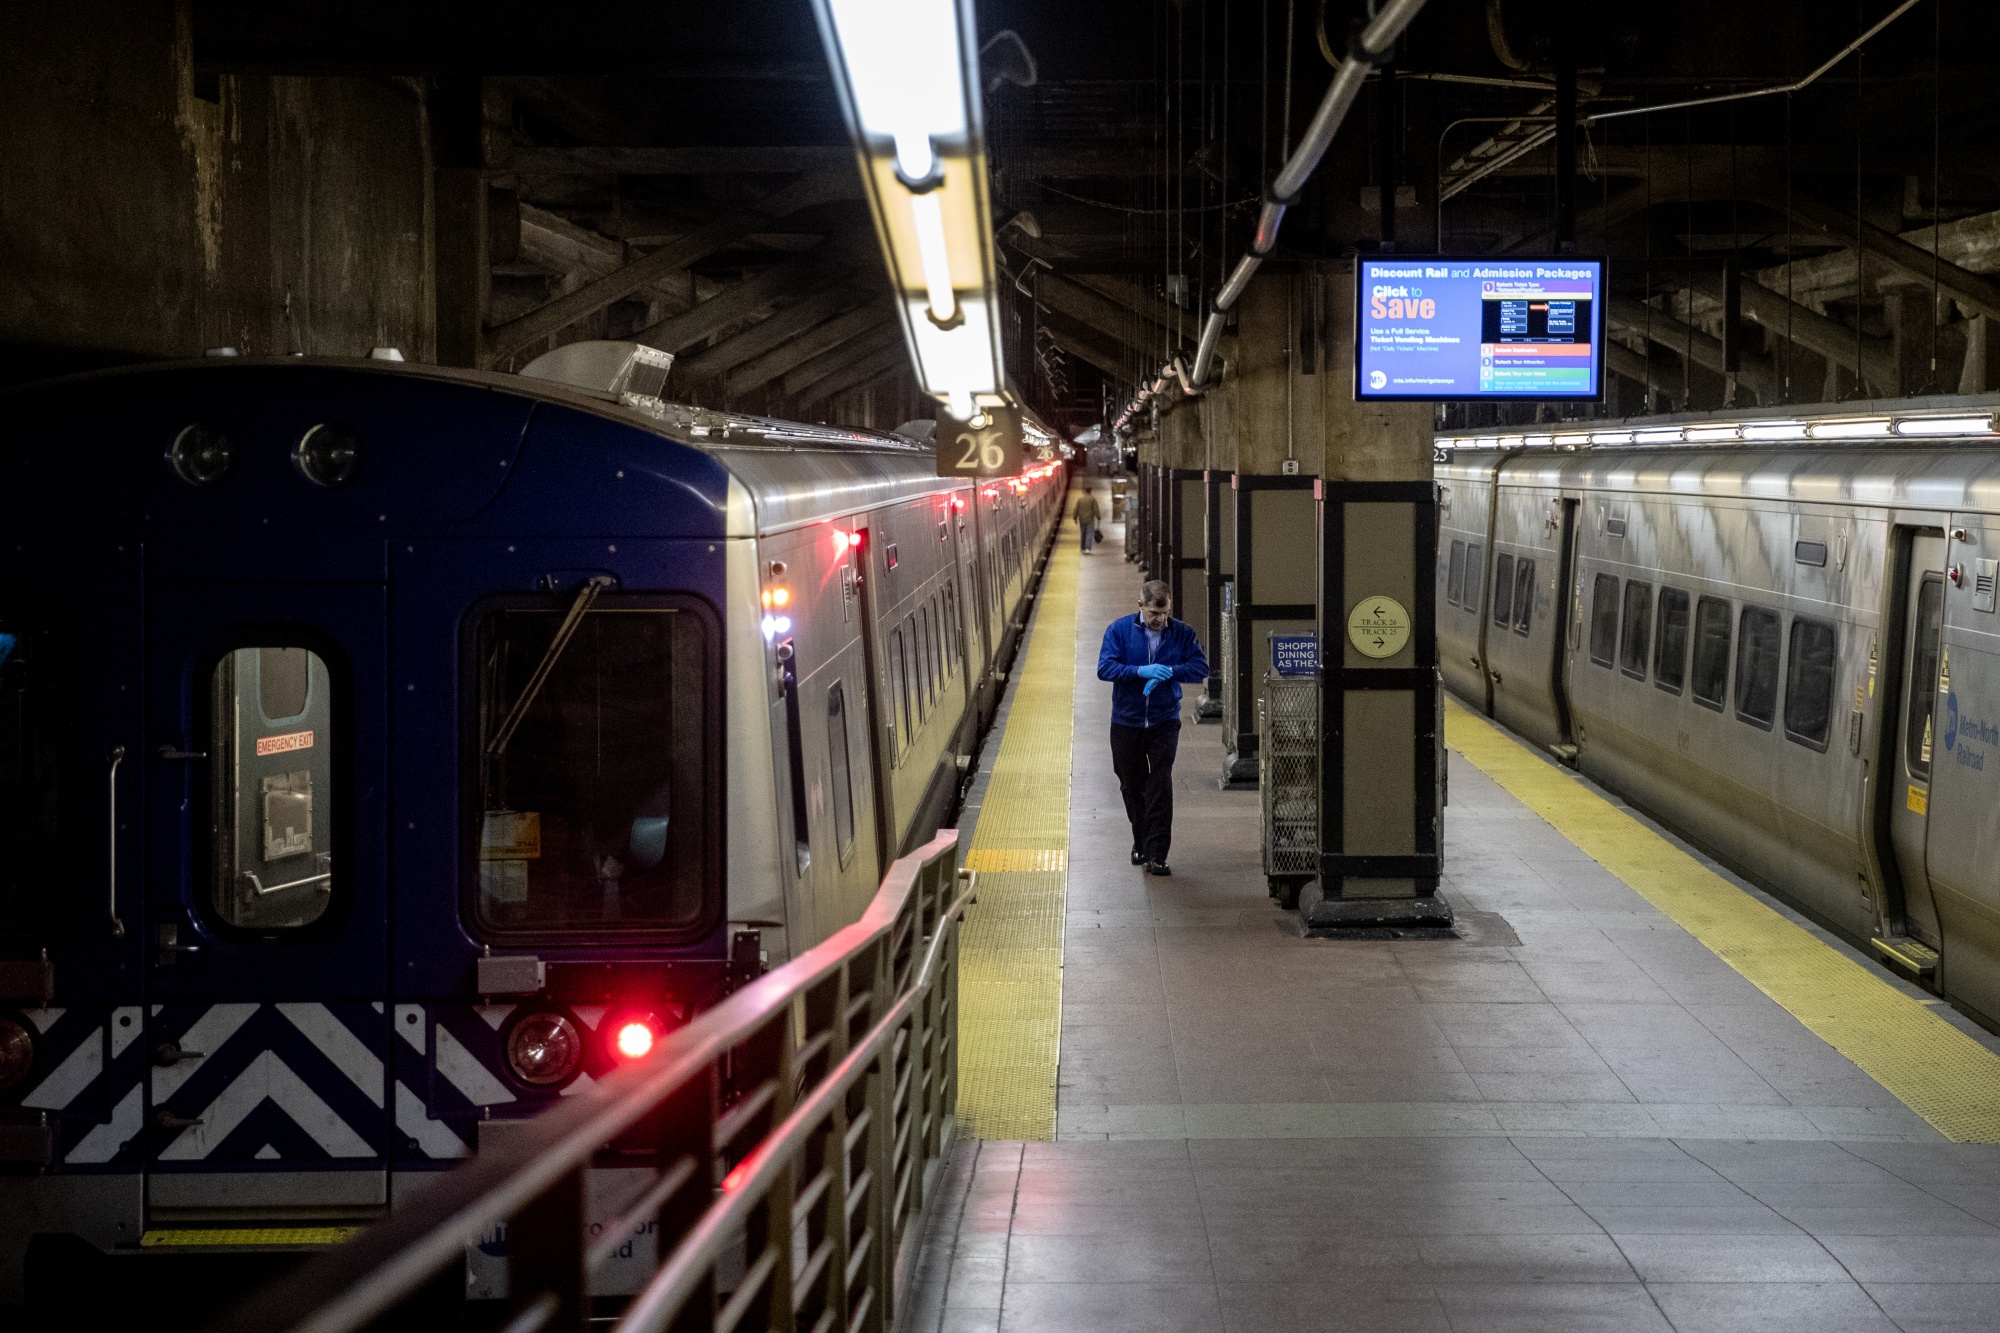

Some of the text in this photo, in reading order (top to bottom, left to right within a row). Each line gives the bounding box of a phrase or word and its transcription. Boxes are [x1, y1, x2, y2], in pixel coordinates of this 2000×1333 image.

[1370, 268, 1592, 280] Discount Rail and Admission Packages
[1373, 285, 1422, 297] Click to
[1371, 296, 1435, 319] Save
[1395, 336, 1424, 344] Vending
[956, 432, 1004, 469] 26
[1037, 446, 1054, 460] 26
[1434, 448, 1447, 462] 25
[1959, 714, 1999, 747] Metro-North
[258, 733, 312, 753] EMERGENCY EXIT
[1957, 744, 1984, 771] Railroad
